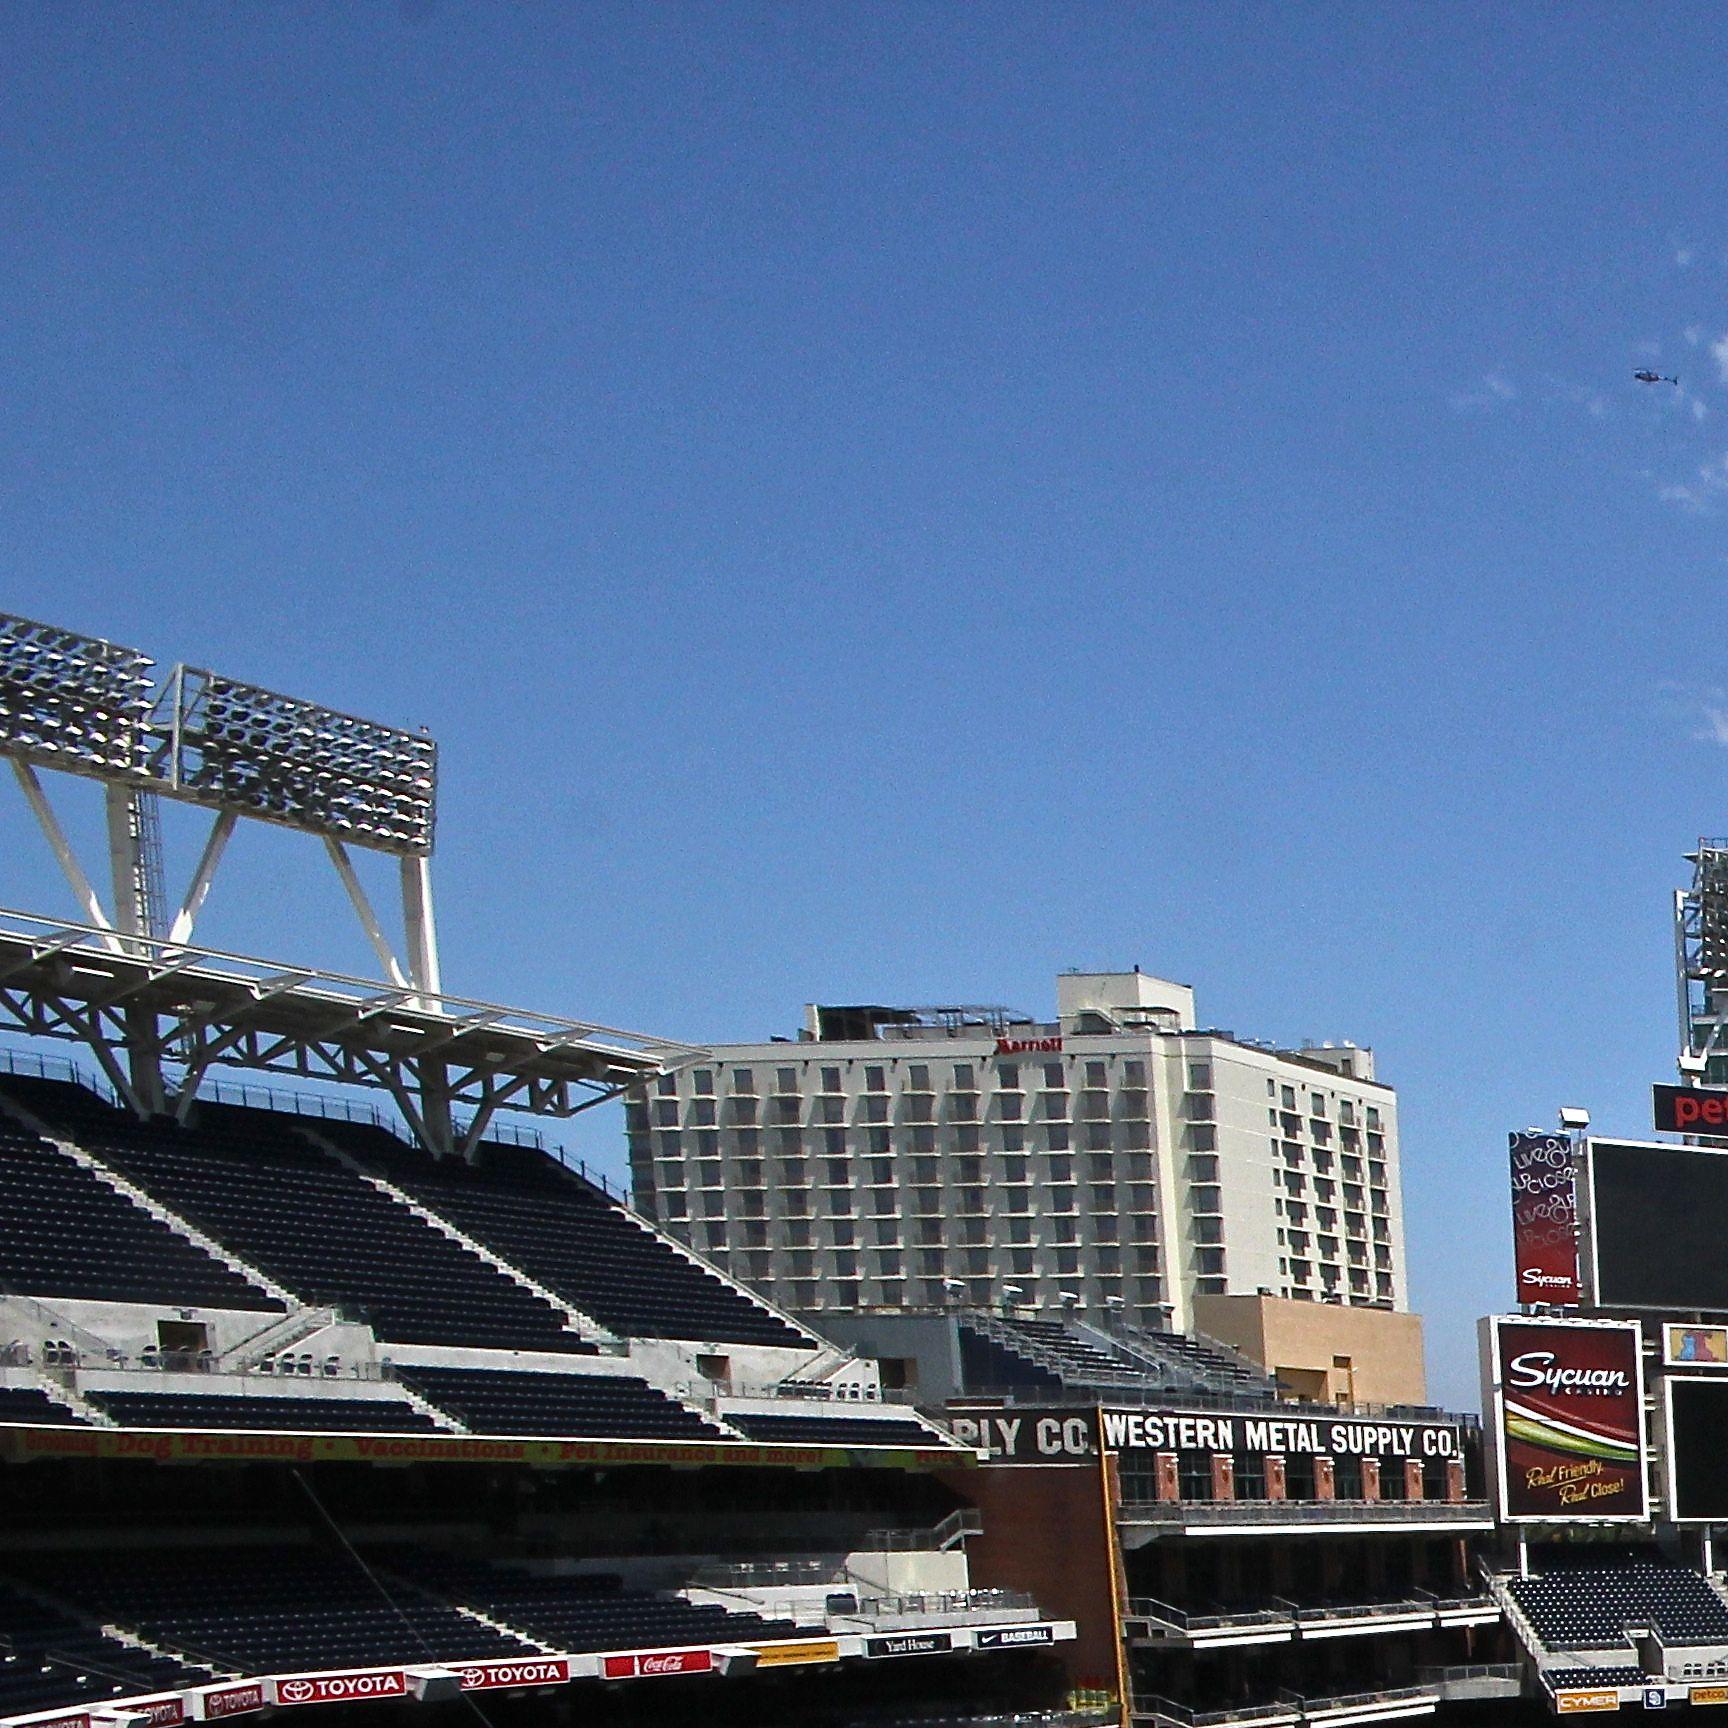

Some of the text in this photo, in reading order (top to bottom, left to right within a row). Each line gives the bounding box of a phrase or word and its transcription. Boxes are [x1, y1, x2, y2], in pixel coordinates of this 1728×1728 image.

[1522, 1268, 1573, 1288] Sycuan
[1510, 1352, 1630, 1396] Sycuan
[1102, 1413, 1459, 1457] WESTERN METAL SUPPLY CO.
[116, 1433, 173, 1460] Dog
[181, 1433, 314, 1462] Training
[354, 1437, 525, 1459] Vaccinations
[604, 1442, 716, 1461] Insurance
[723, 1447, 760, 1463] and
[1001, 1630, 1049, 1643] BASEBALL
[487, 1664, 561, 1683] TOYOTA
[316, 1675, 400, 1696] TOYOTA
[1692, 1689, 1727, 1700] petco
[223, 1690, 260, 1709] TOYOTA
[1558, 1694, 1618, 1709] CYMER
